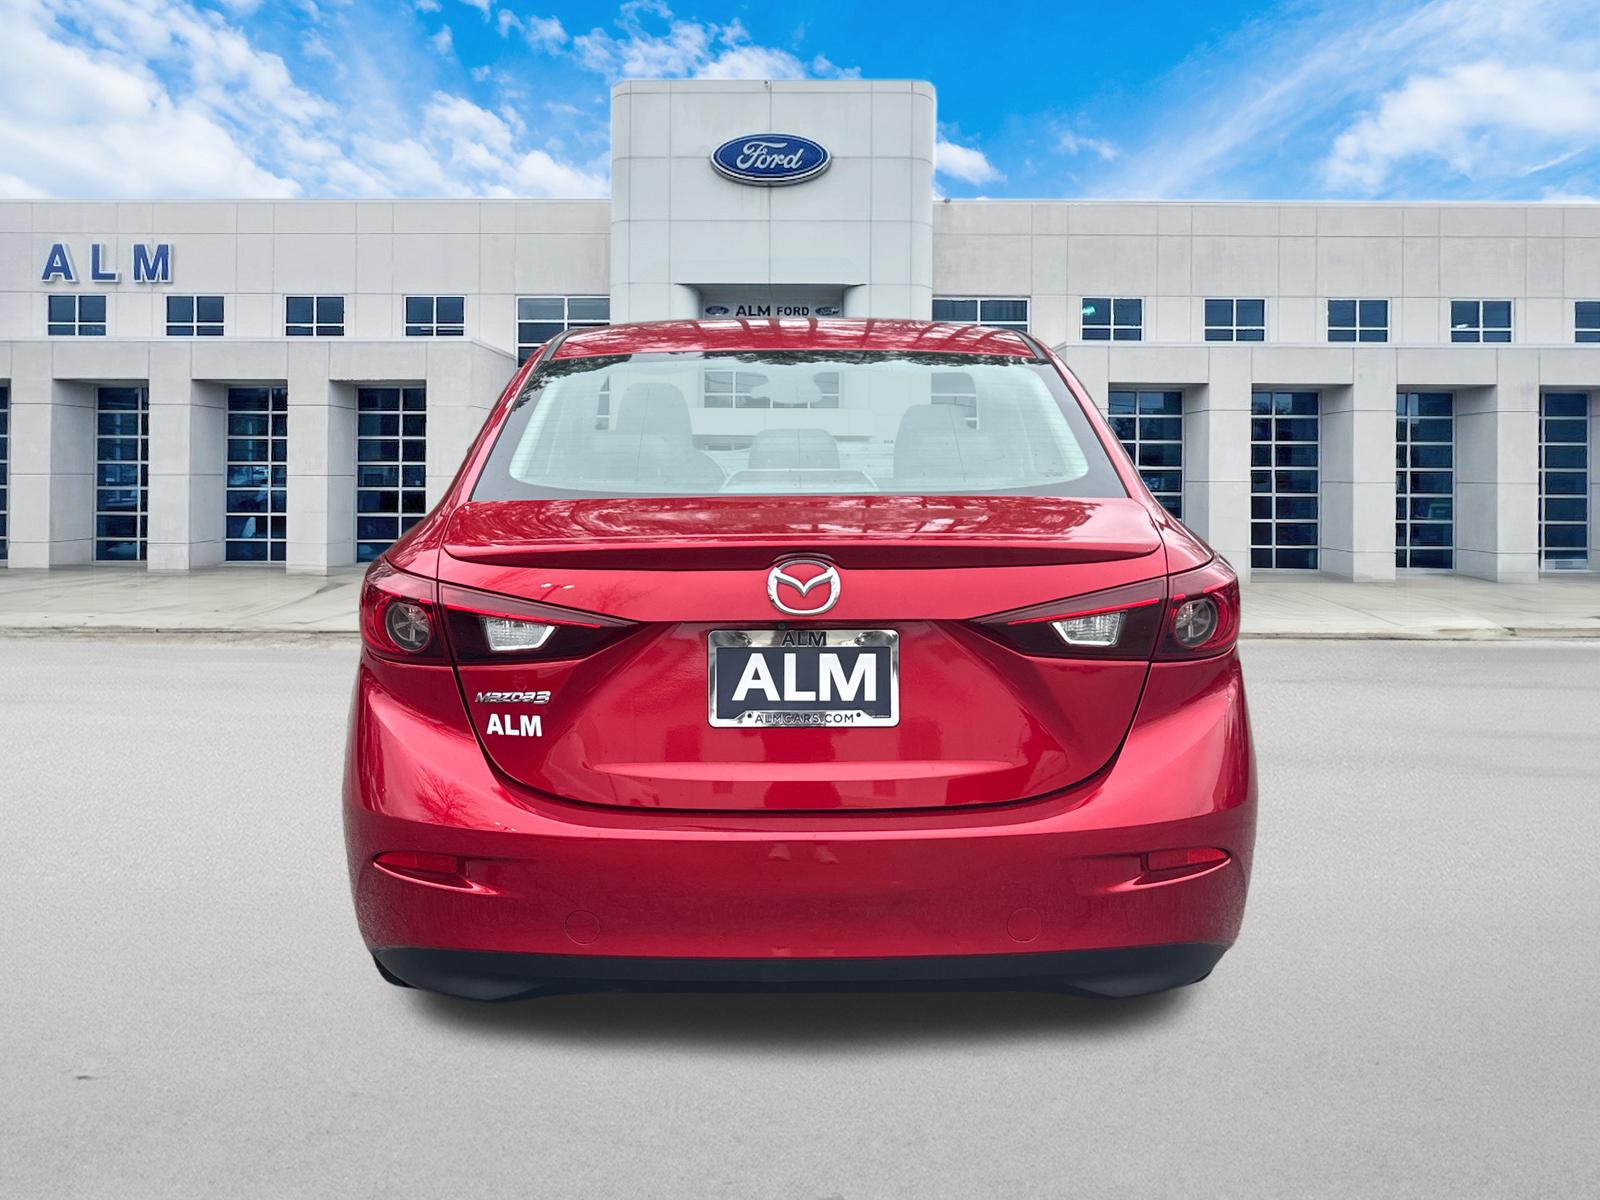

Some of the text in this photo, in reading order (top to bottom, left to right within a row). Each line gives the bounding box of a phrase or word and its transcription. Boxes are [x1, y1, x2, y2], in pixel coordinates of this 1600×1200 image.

[736, 140, 804, 170] Ford
[41, 243, 171, 281] ALM
[735, 305, 771, 317] ALM
[776, 306, 810, 316] FORD
[781, 631, 827, 646] ALM
[731, 653, 877, 702] ALM
[486, 713, 543, 737] ALM
[754, 711, 854, 724] ALMCARS.COM
